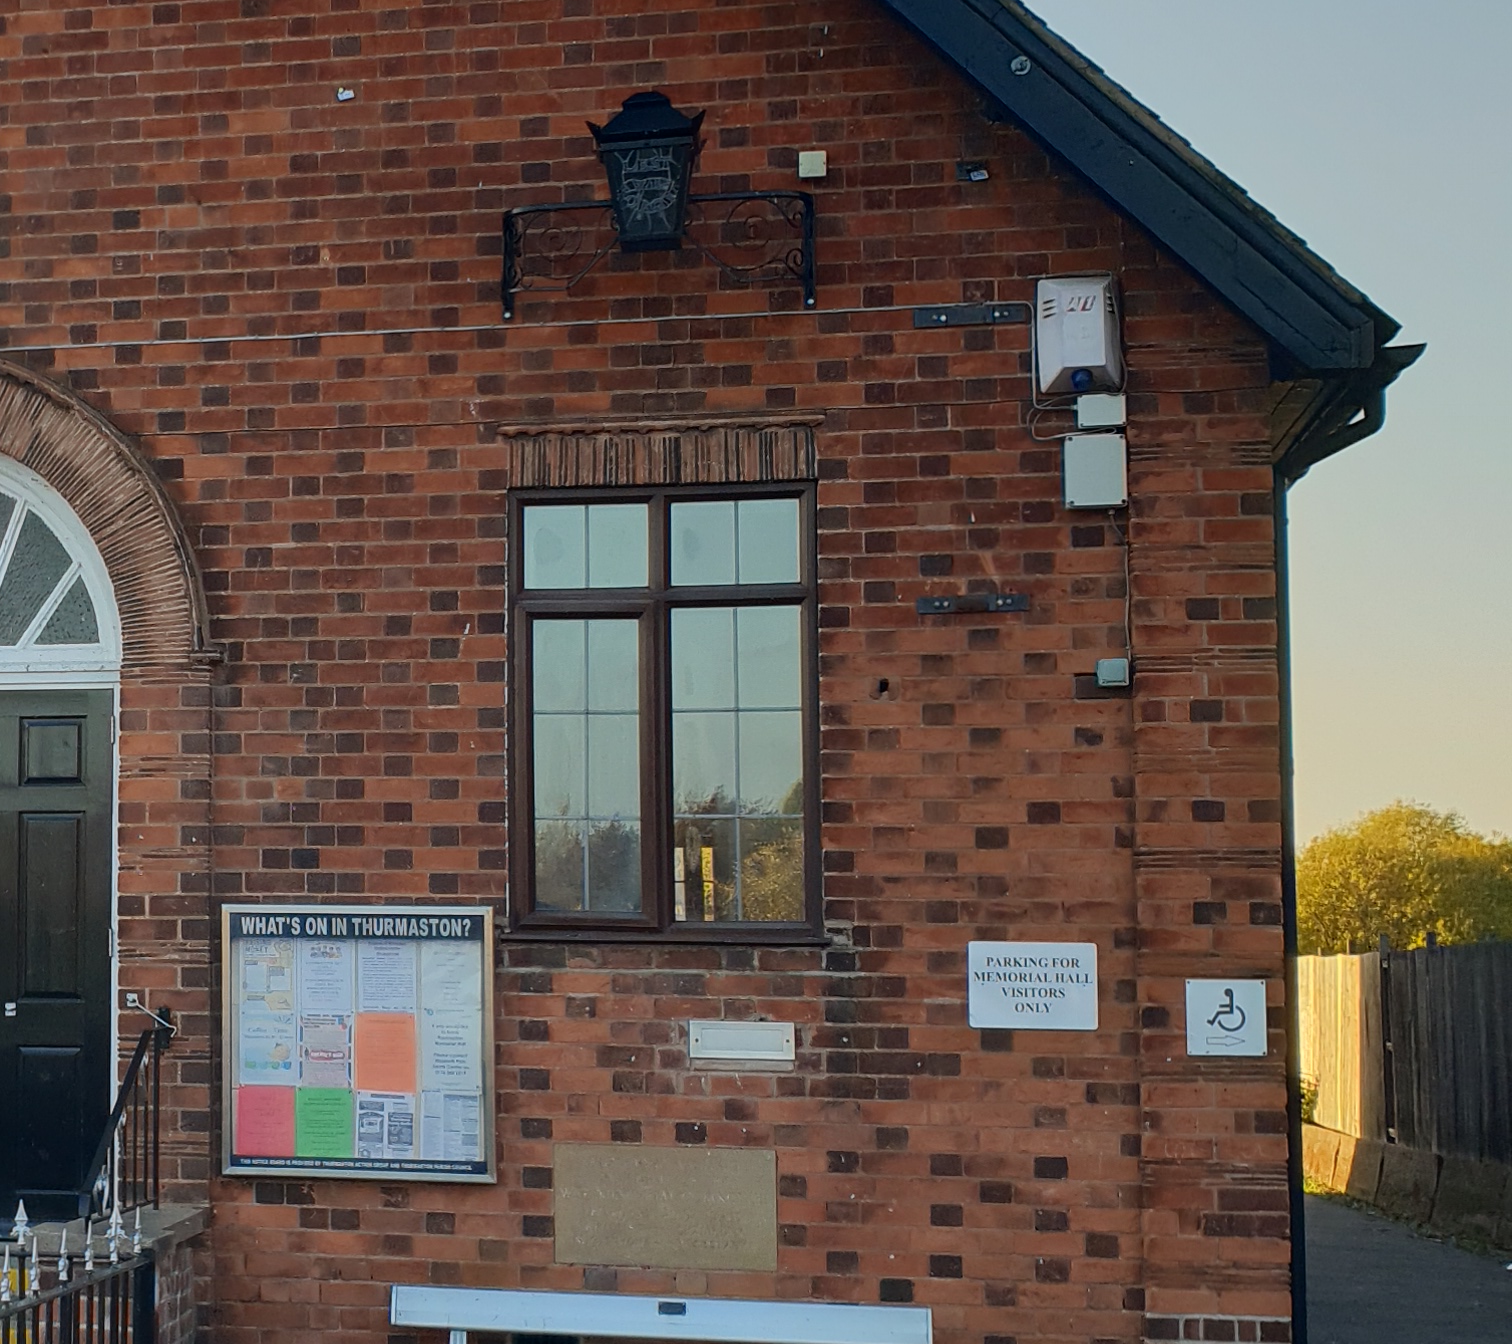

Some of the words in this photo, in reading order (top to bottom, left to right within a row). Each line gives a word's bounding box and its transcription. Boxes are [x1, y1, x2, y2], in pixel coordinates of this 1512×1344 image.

[241, 916, 301, 935] WHAT'S
[305, 917, 327, 936] ON
[332, 918, 347, 936] IN
[351, 918, 470, 937] THURMASTON?
[986, 957, 1048, 968] PARKING
[1052, 957, 1080, 968] FOR
[974, 971, 1052, 983] MEMORIAL
[1055, 973, 1093, 984] HALL
[1001, 987, 1065, 999] VISITORS
[1014, 1002, 1052, 1014] ONLY
